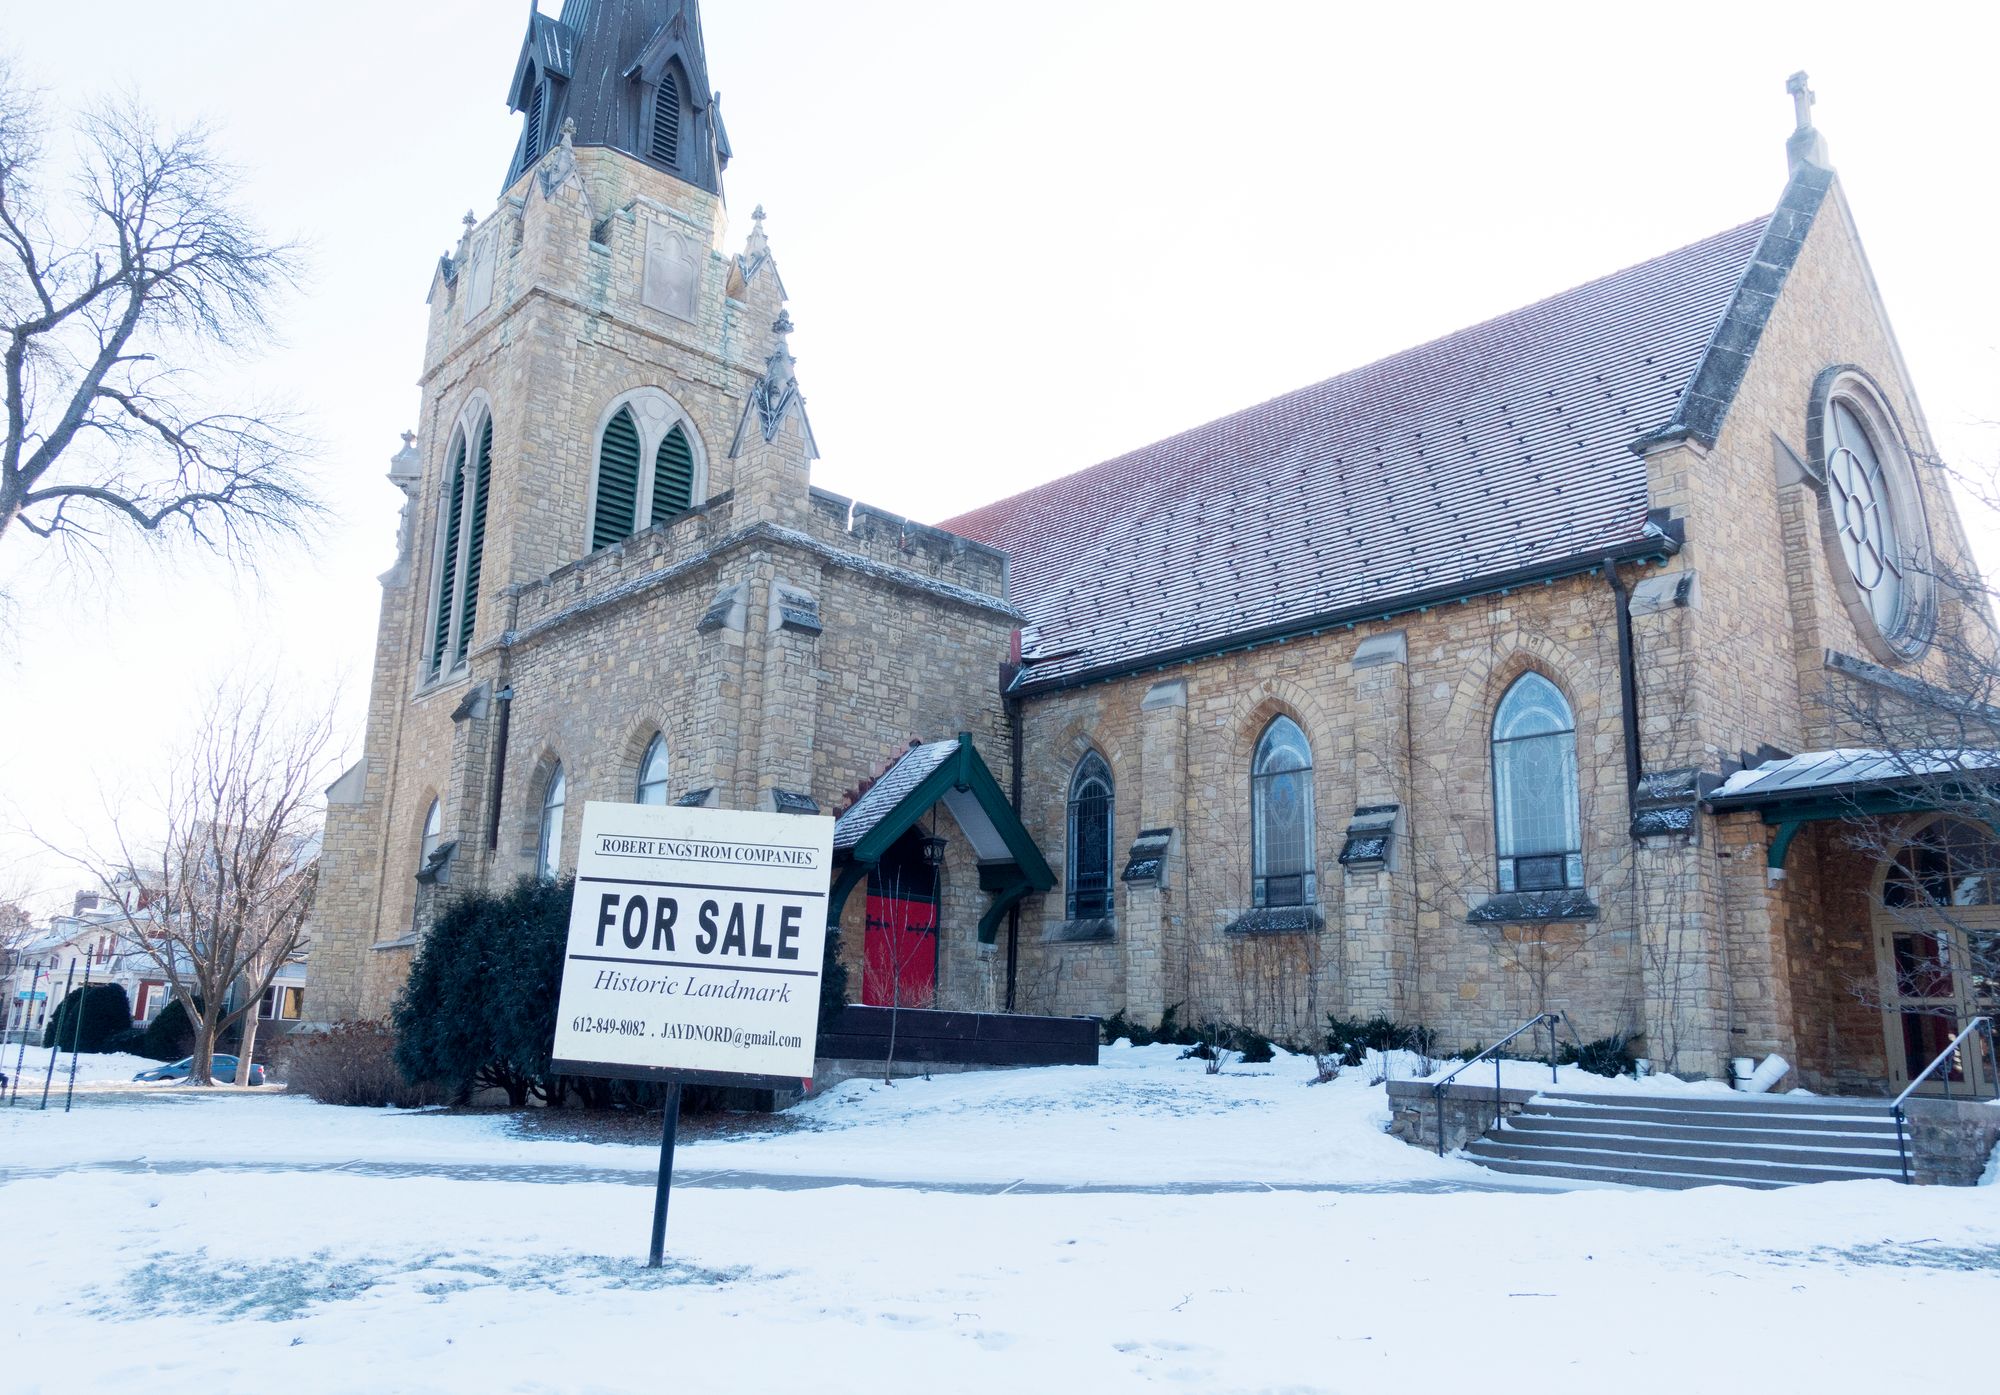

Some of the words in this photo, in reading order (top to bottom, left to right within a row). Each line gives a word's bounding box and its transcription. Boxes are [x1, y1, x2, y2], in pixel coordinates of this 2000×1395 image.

[602, 838, 655, 855] ROBERT
[658, 842, 732, 859] ENGSTROM
[735, 847, 812, 865] COMPANIES
[595, 893, 679, 951] FOR
[695, 899, 803, 960] SALE
[593, 970, 679, 995] Historic
[684, 976, 793, 1003] Landmark
[572, 1016, 646, 1037] 612-849-8082
[660, 1022, 802, 1049] JAYDNORD@gmail.com
